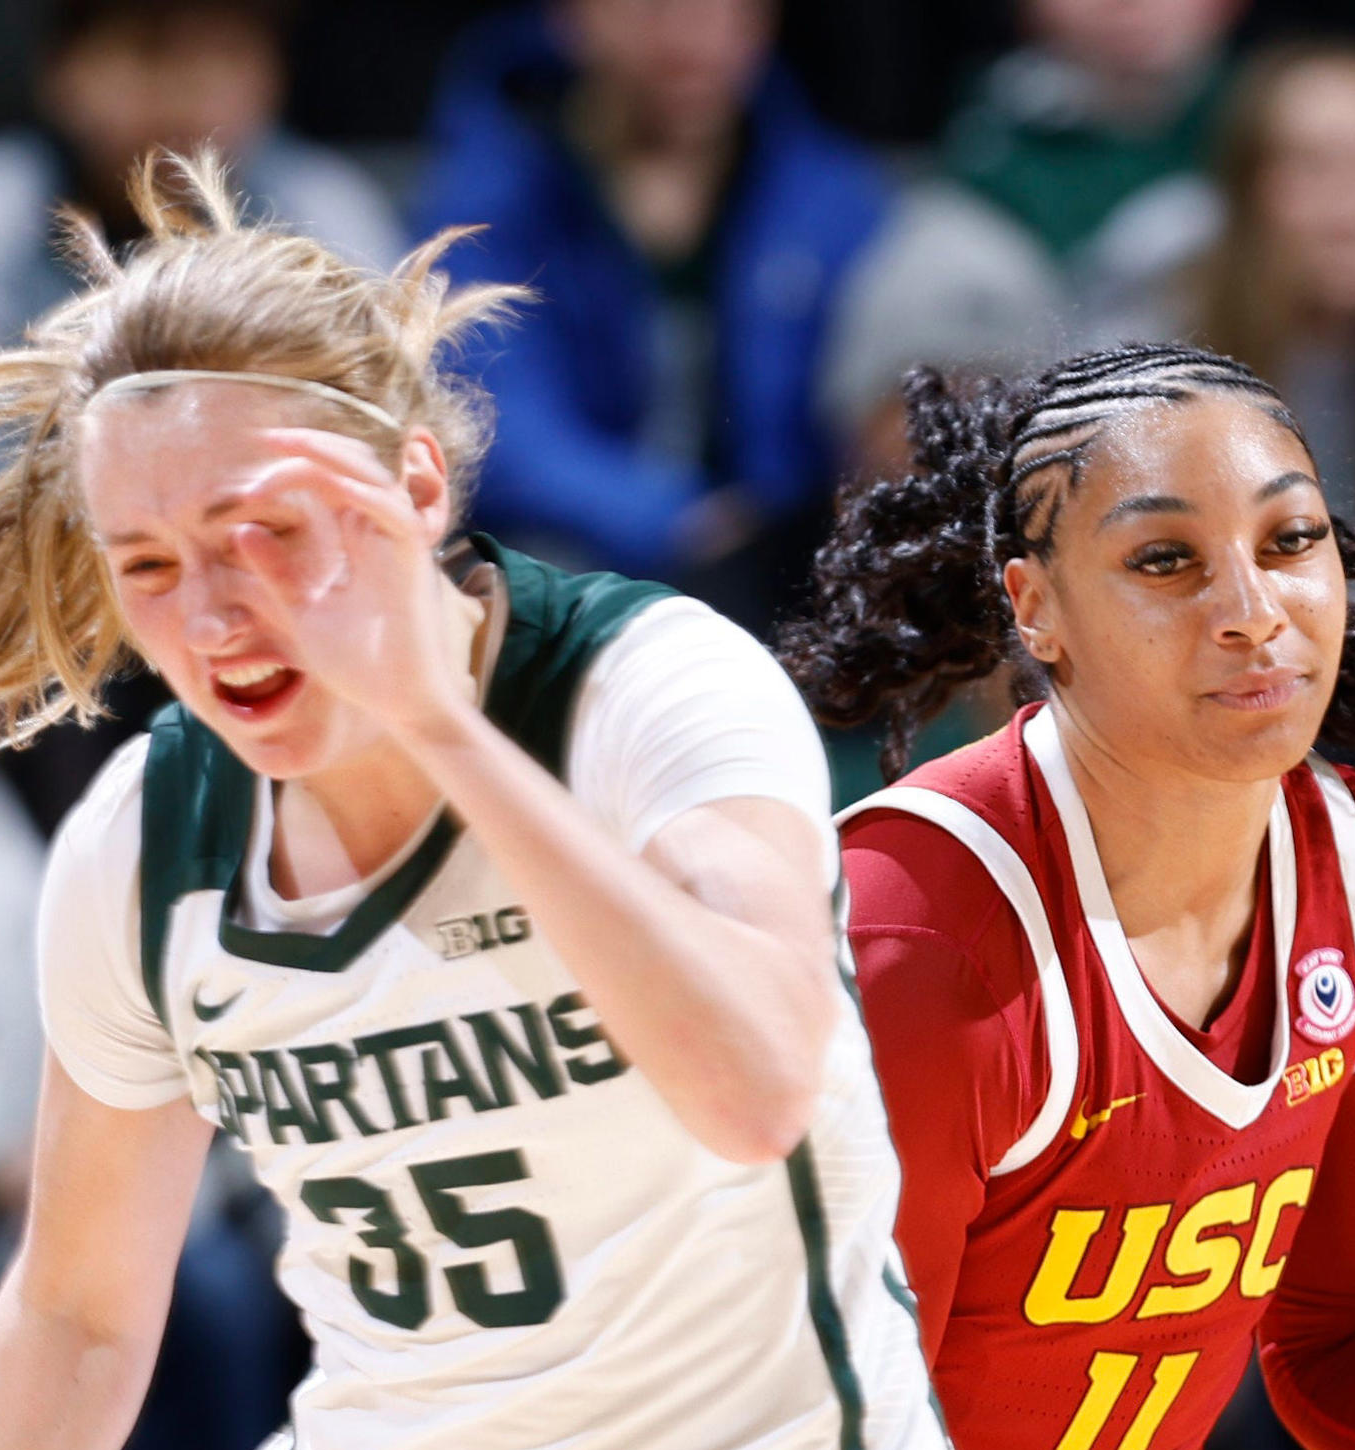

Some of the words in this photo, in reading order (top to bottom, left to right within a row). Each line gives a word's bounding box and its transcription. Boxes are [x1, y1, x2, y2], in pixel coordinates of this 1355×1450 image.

[433, 904, 531, 961] BIG
[1282, 1047, 1345, 1107] BIG
[300, 1147, 568, 1331] 35
[1022, 1166, 1316, 1327] USC
